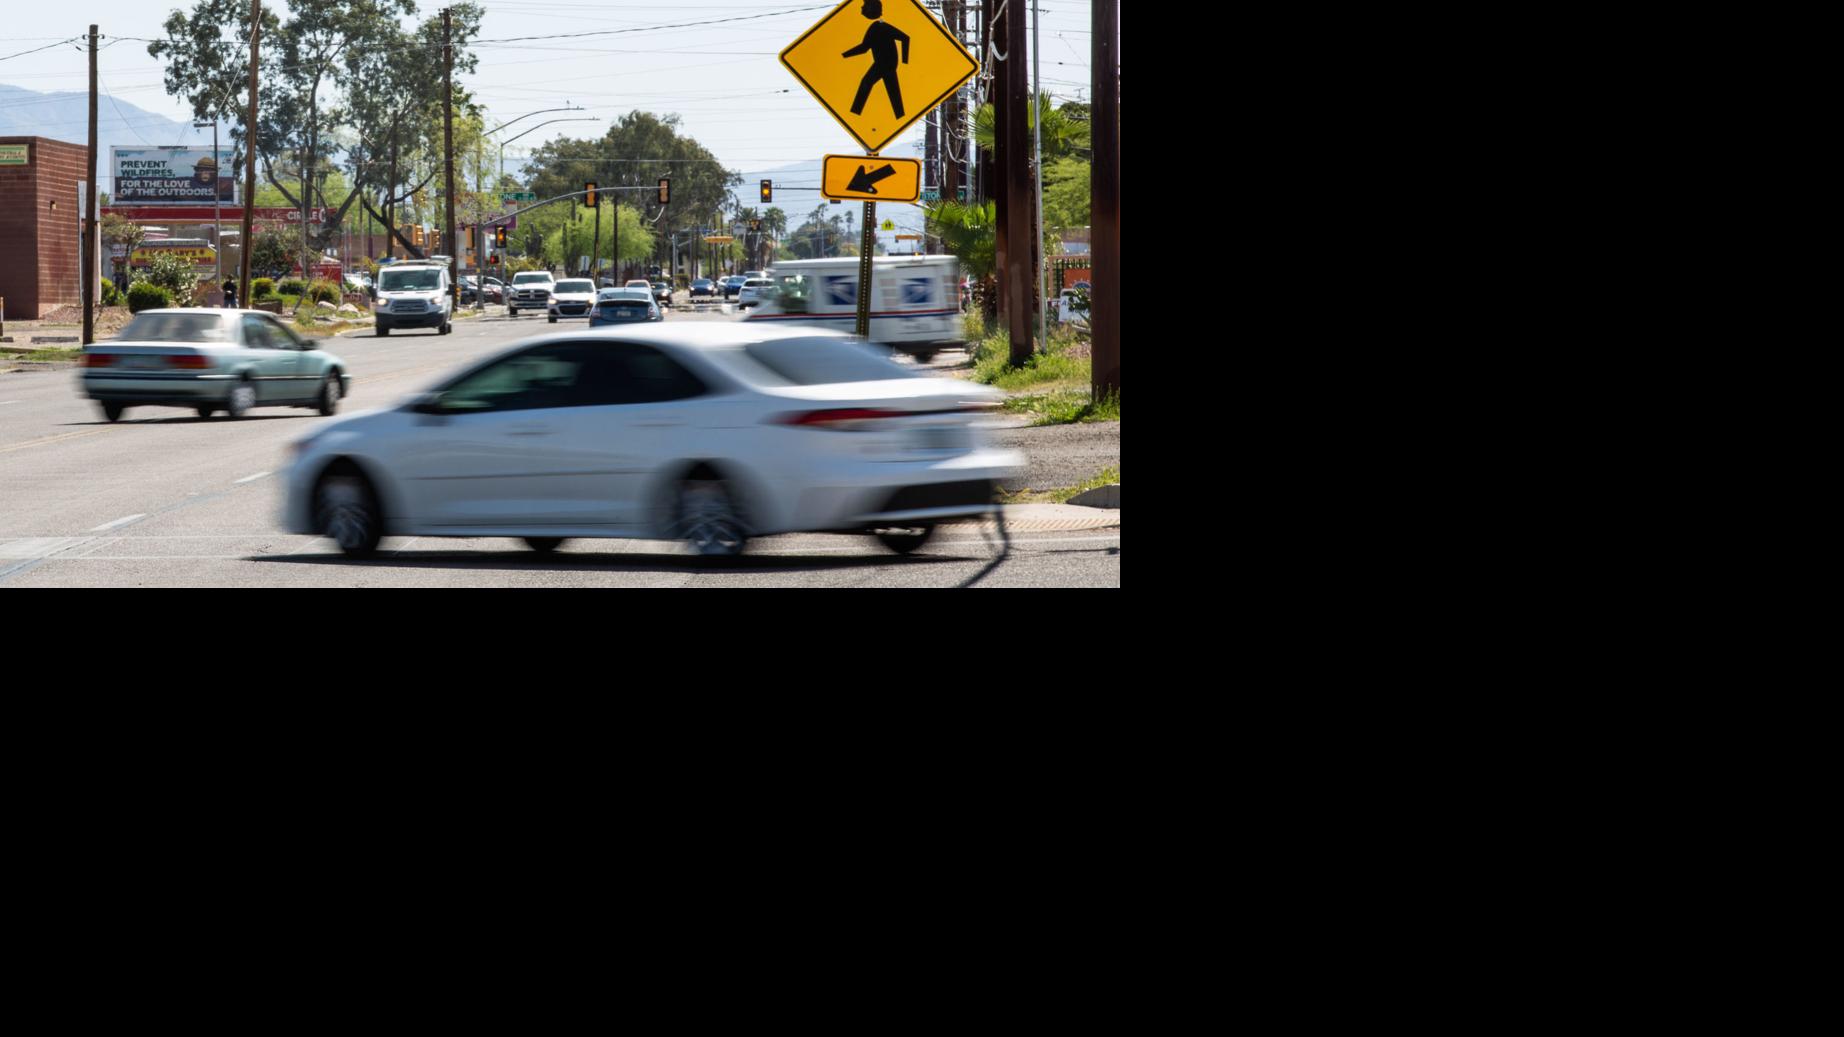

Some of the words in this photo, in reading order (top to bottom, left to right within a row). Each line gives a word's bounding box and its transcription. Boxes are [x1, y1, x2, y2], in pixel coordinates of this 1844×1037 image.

[121, 160, 167, 168] PREVENT
[121, 169, 176, 178] WILDFIRES,
[121, 180, 141, 188] FOR
[143, 180, 163, 188] THE
[164, 180, 190, 188] LOVE
[120, 188, 133, 196] OF
[137, 188, 157, 196] THE
[158, 188, 216, 196] OUTDOORS.
[287, 211, 318, 220] CIRLE
